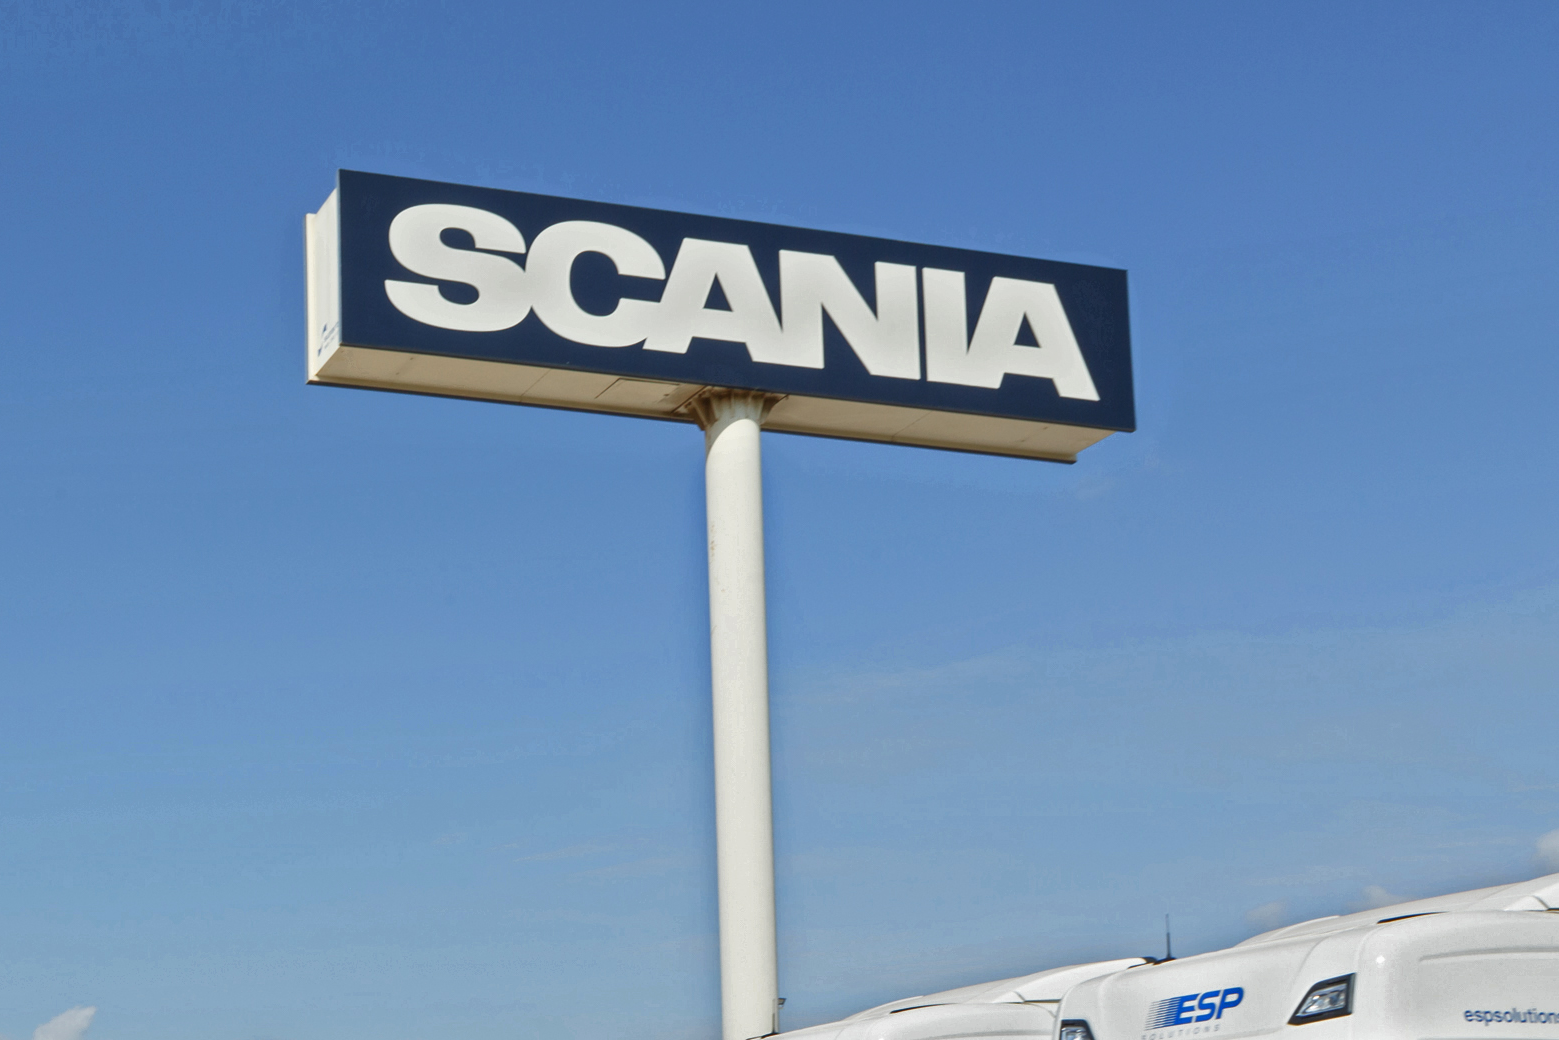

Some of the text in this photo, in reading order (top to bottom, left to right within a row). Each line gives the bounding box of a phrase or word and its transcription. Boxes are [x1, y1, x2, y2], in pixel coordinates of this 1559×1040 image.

[384, 203, 1100, 402] SCANIA
[1163, 986, 1245, 1027] ESP
[1464, 1007, 1559, 1027] espsolution
